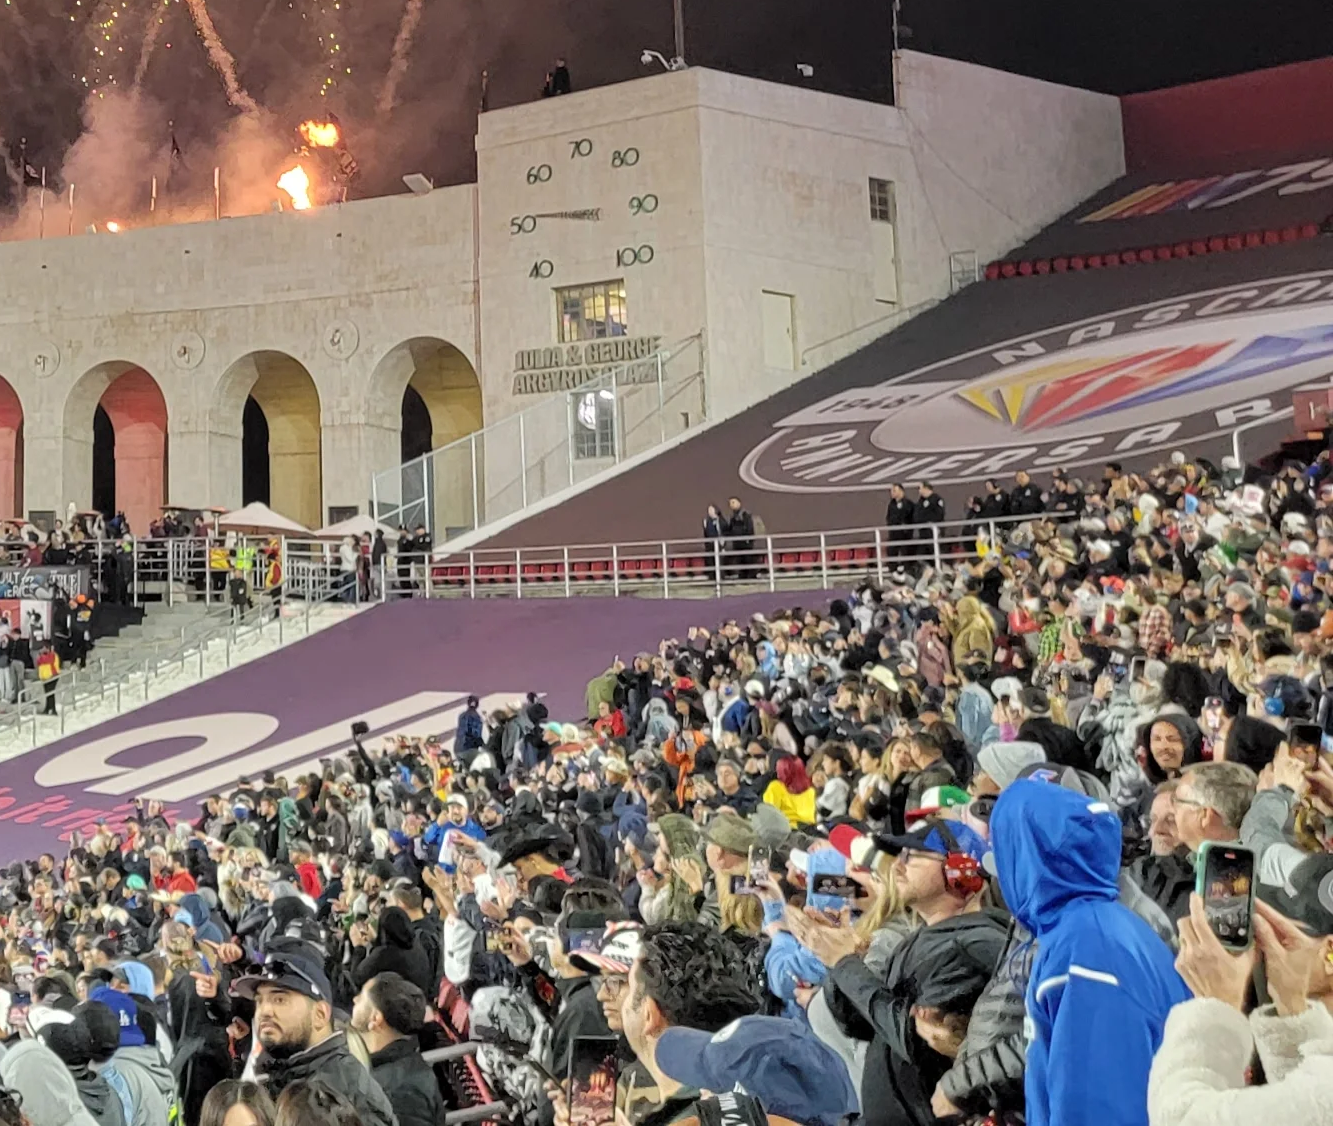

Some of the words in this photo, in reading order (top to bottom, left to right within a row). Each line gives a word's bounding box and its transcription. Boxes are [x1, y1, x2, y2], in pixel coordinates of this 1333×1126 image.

[568, 138, 593, 159] 70
[611, 147, 640, 168] 80
[526, 164, 553, 185] 60
[629, 194, 659, 216] 90
[510, 215, 537, 235] 50
[616, 245, 654, 268] 100
[528, 259, 554, 279] 40
[514, 347, 564, 372] JULIA
[585, 336, 661, 364] GEORGE
[815, 391, 921, 415] 1948
[780, 398, 1278, 483] ANNIVERSAR
